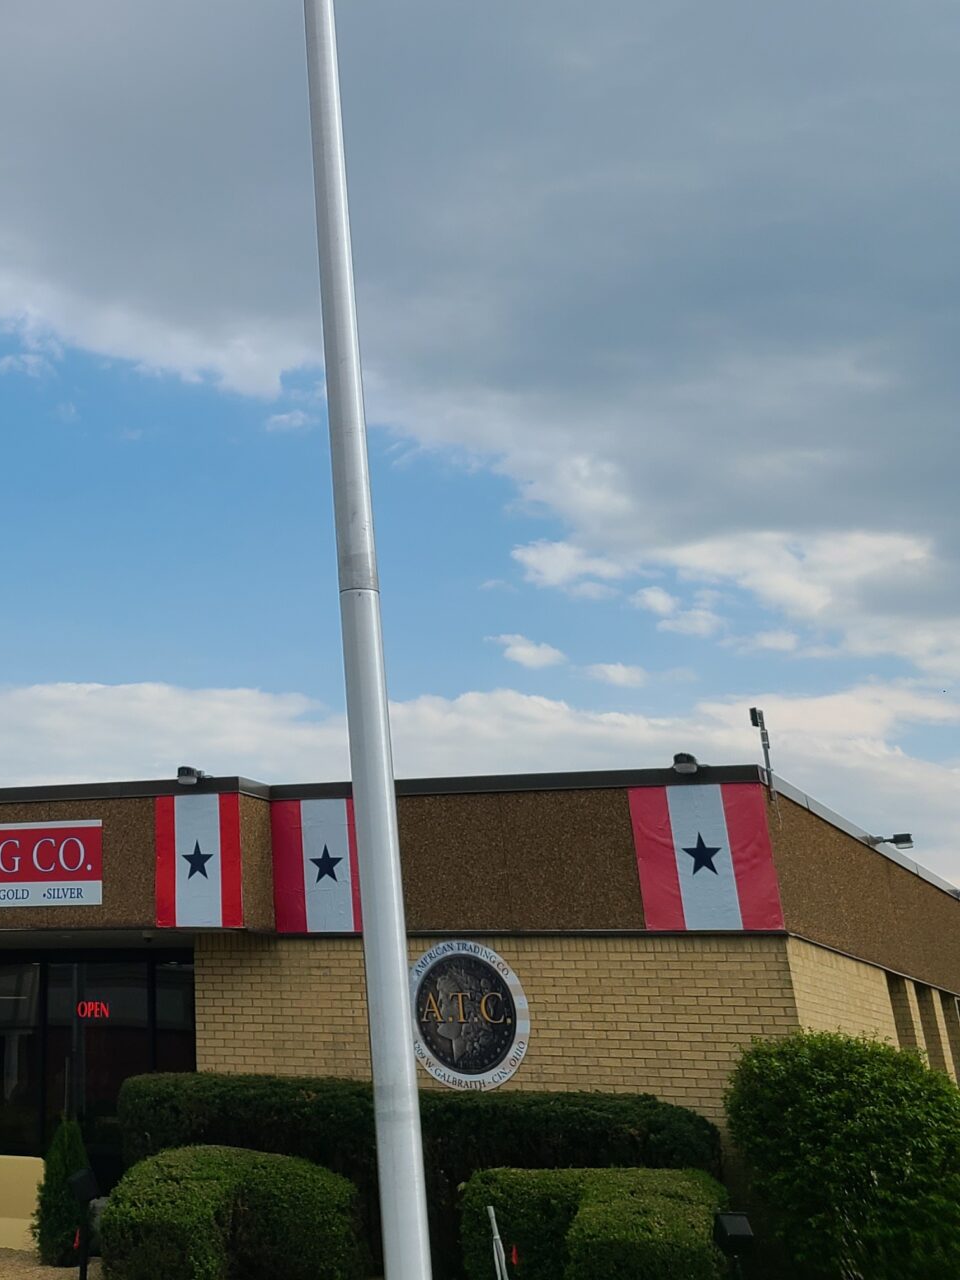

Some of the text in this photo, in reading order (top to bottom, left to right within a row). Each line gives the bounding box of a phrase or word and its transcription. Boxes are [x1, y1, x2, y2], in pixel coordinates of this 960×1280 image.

[32, 837, 92, 872] CO.
[46, 888, 84, 900] SILVER
[415, 942, 509, 978] AMERICAN TRADING CO.
[77, 1001, 110, 1018] OPEN
[421, 992, 512, 1024] A.T.C.
[434, 1067, 486, 1090] GALBRAITH
[509, 1040, 525, 1067] OHIO
